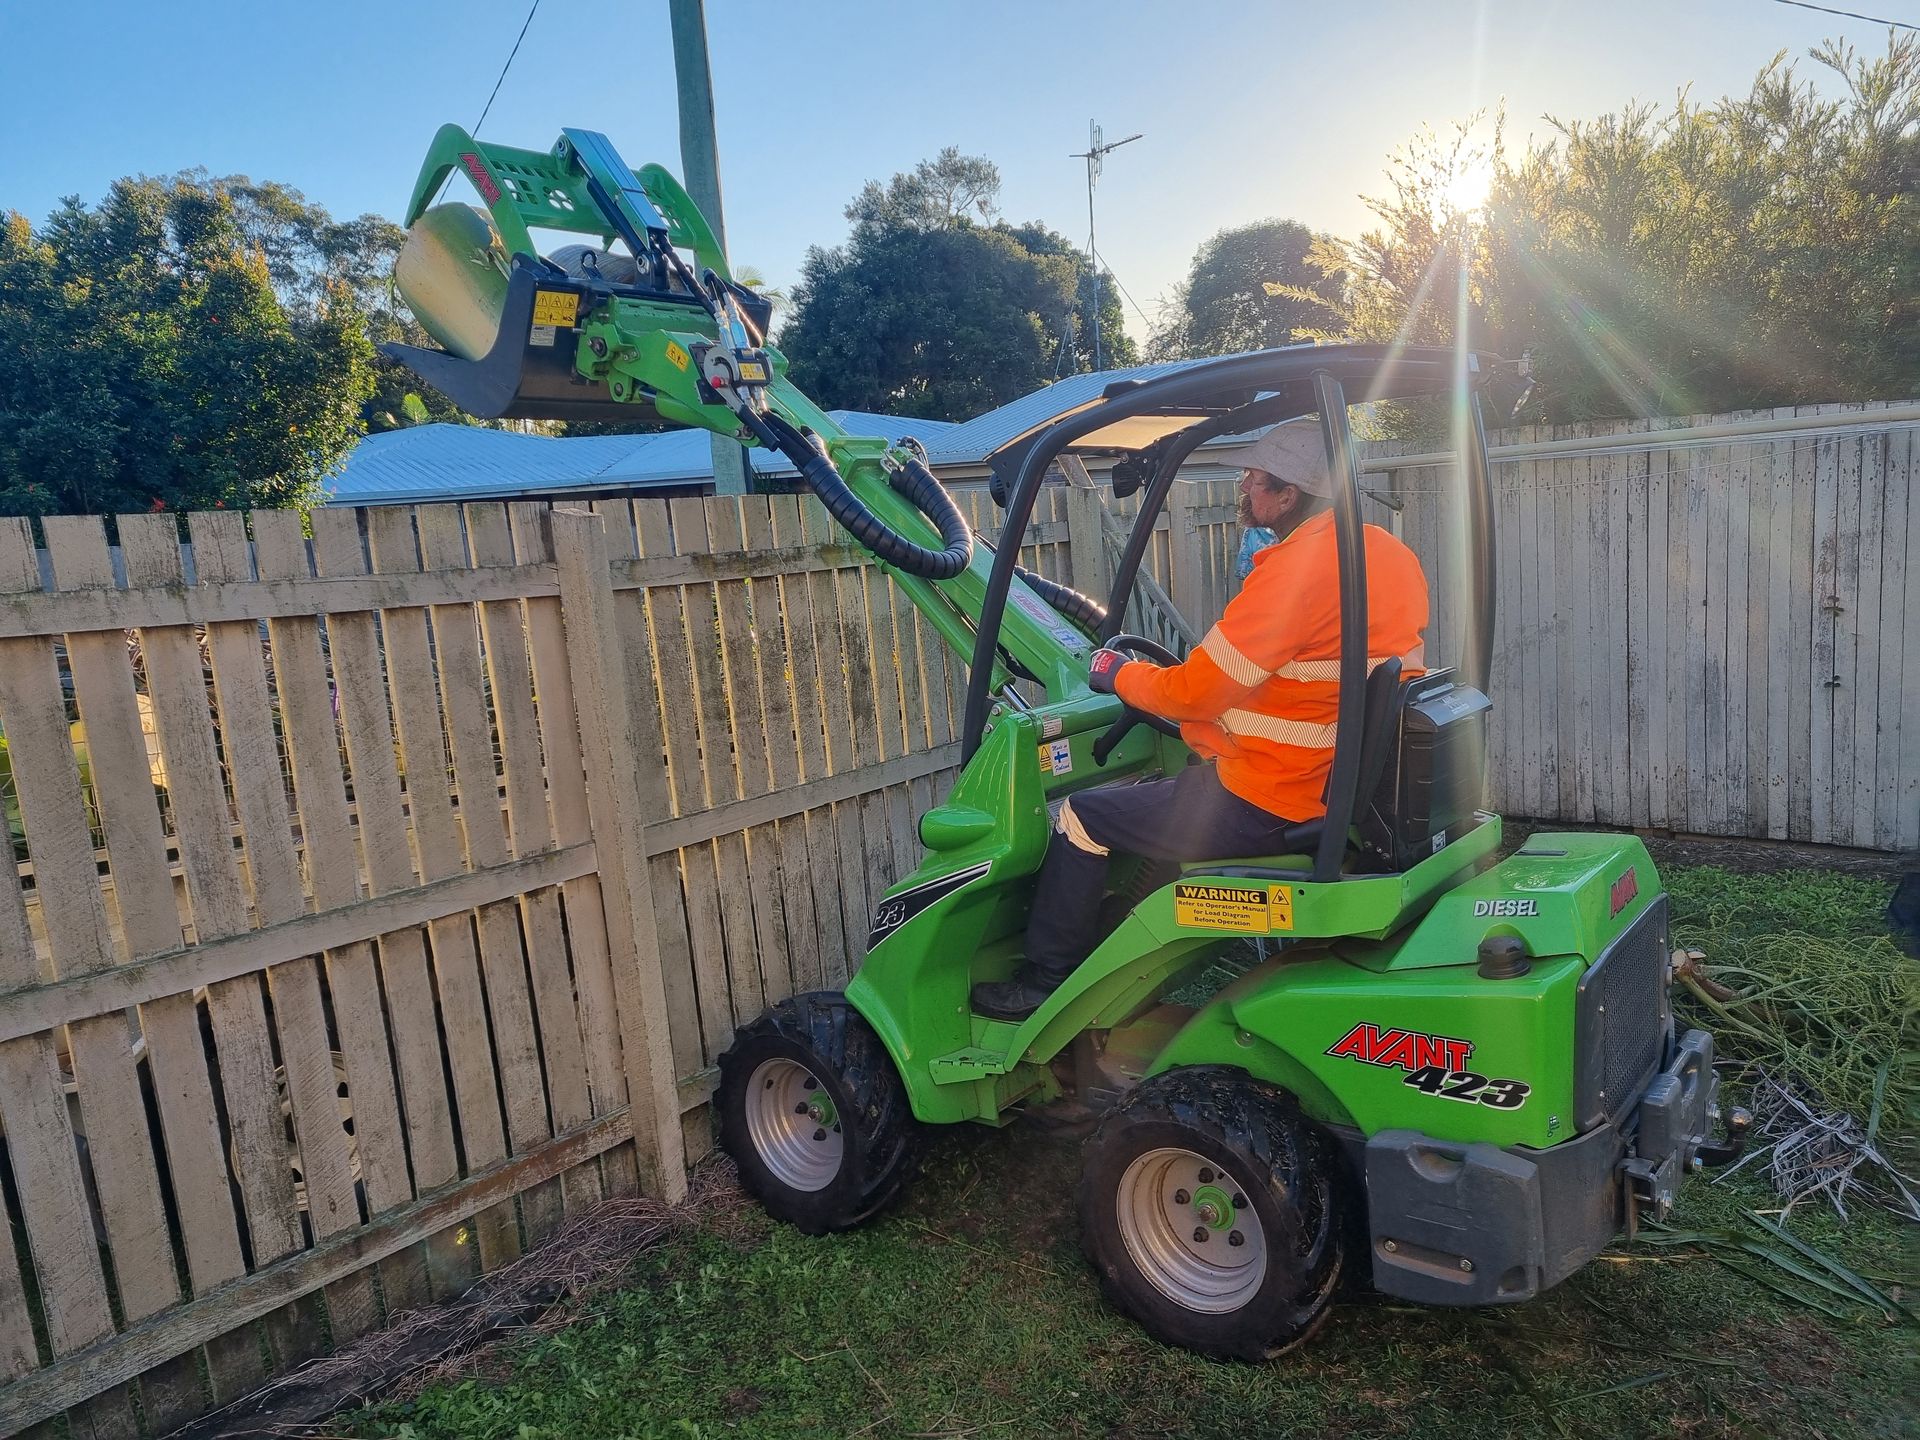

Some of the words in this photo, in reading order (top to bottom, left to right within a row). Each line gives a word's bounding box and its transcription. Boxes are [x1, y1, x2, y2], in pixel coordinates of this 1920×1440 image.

[458, 152, 502, 208] AVANT
[1181, 886, 1260, 903] WARNING
[1205, 902, 1240, 910] Operator's
[871, 900, 906, 933] 23
[1222, 911, 1250, 919] Diagram
[1473, 900, 1538, 917] DIESEL
[1323, 1021, 1475, 1073] AVANT
[1402, 1065, 1532, 1111] 423
